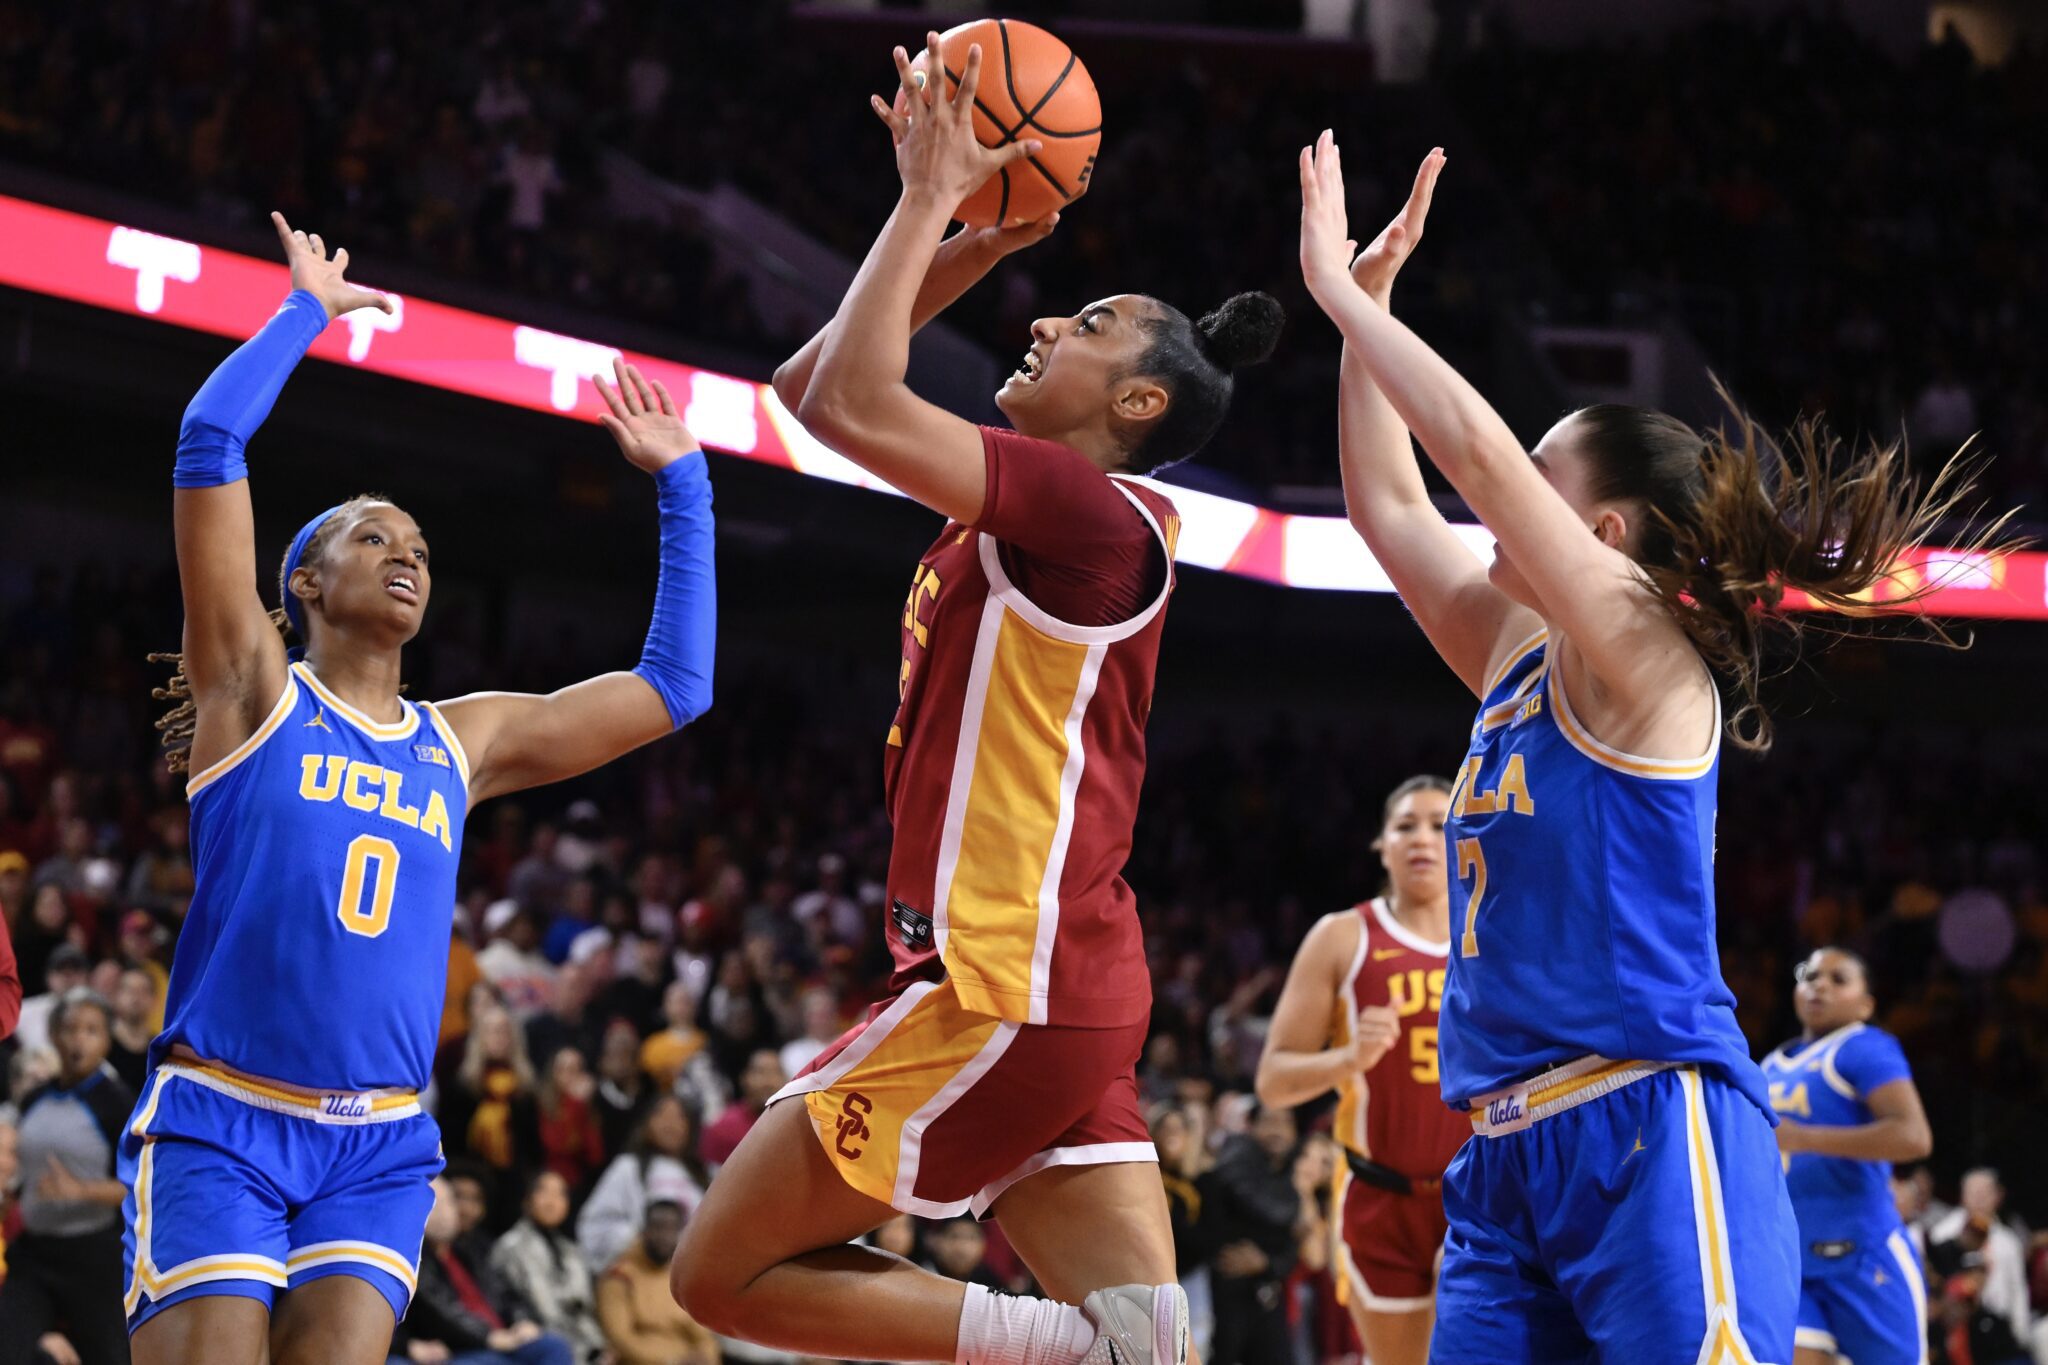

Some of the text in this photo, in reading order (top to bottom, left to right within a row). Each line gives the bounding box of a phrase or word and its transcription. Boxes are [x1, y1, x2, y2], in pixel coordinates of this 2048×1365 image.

[299, 754, 452, 853] UCLA
[337, 833, 401, 938] 0
[1455, 836, 1488, 958] 7
[916, 924, 927, 936] 46
[1387, 969, 1446, 1018] US
[1409, 1026, 1440, 1084] 5
[326, 1094, 367, 1117] Ucla
[1490, 1094, 1523, 1126] Ucla
